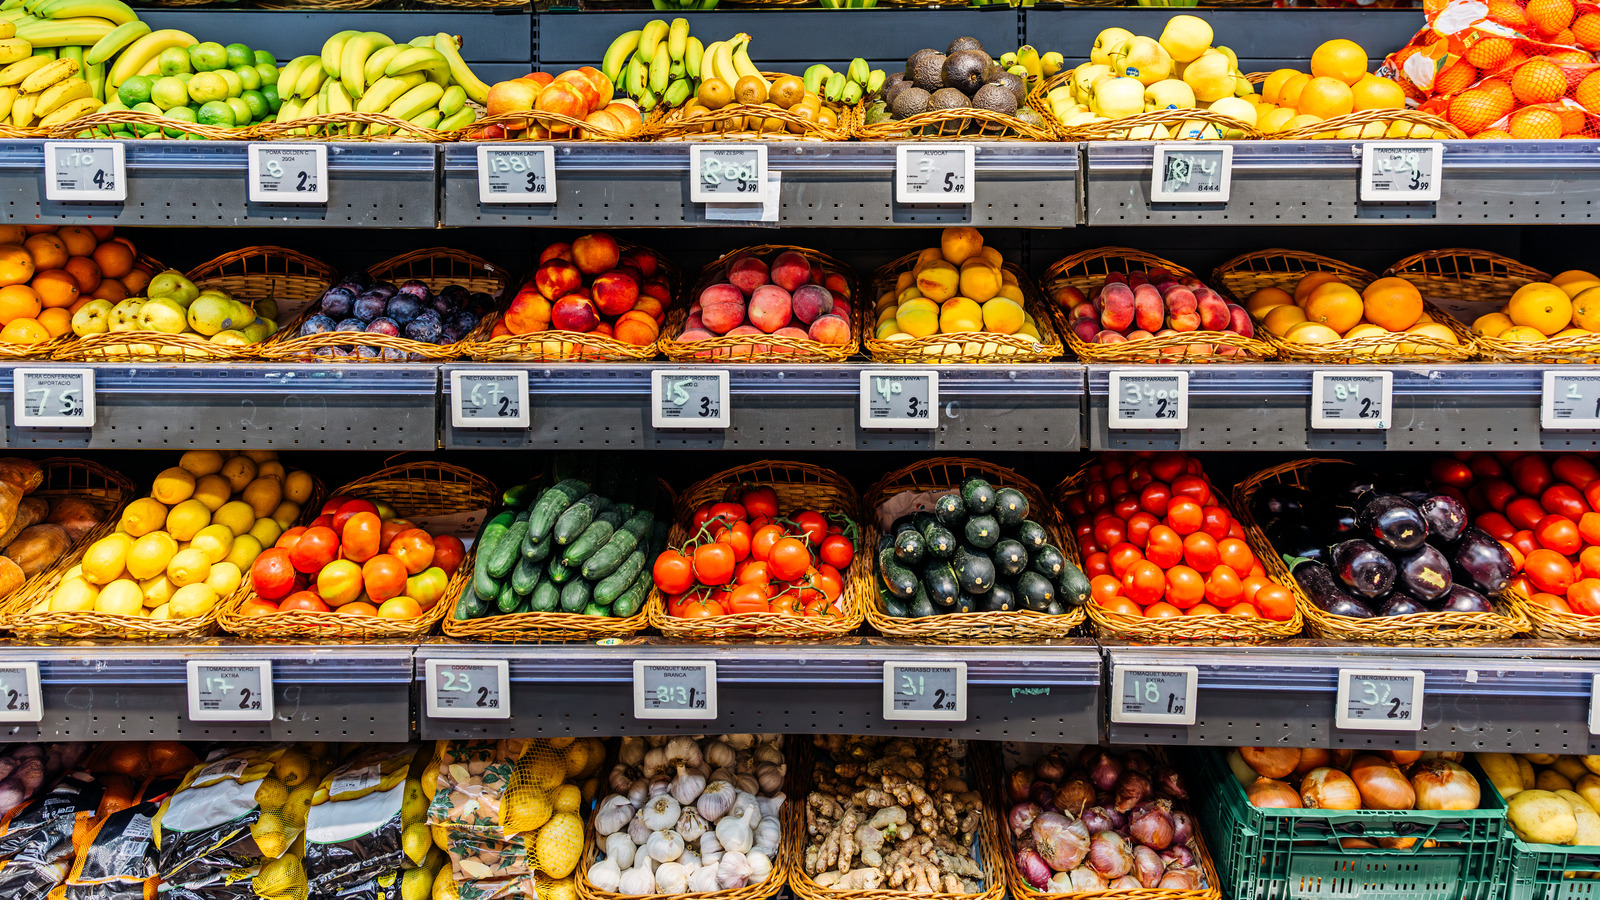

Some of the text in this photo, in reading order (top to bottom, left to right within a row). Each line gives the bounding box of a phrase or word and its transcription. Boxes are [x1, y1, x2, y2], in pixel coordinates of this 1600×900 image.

[472, 383, 504, 407] 67
[1335, 383, 1359, 400] 84
[206, 677, 234, 695] 17
[441, 671, 472, 693] 23
[902, 675, 925, 696] 31
[1134, 681, 1160, 703] 18
[1362, 681, 1396, 706] 32
